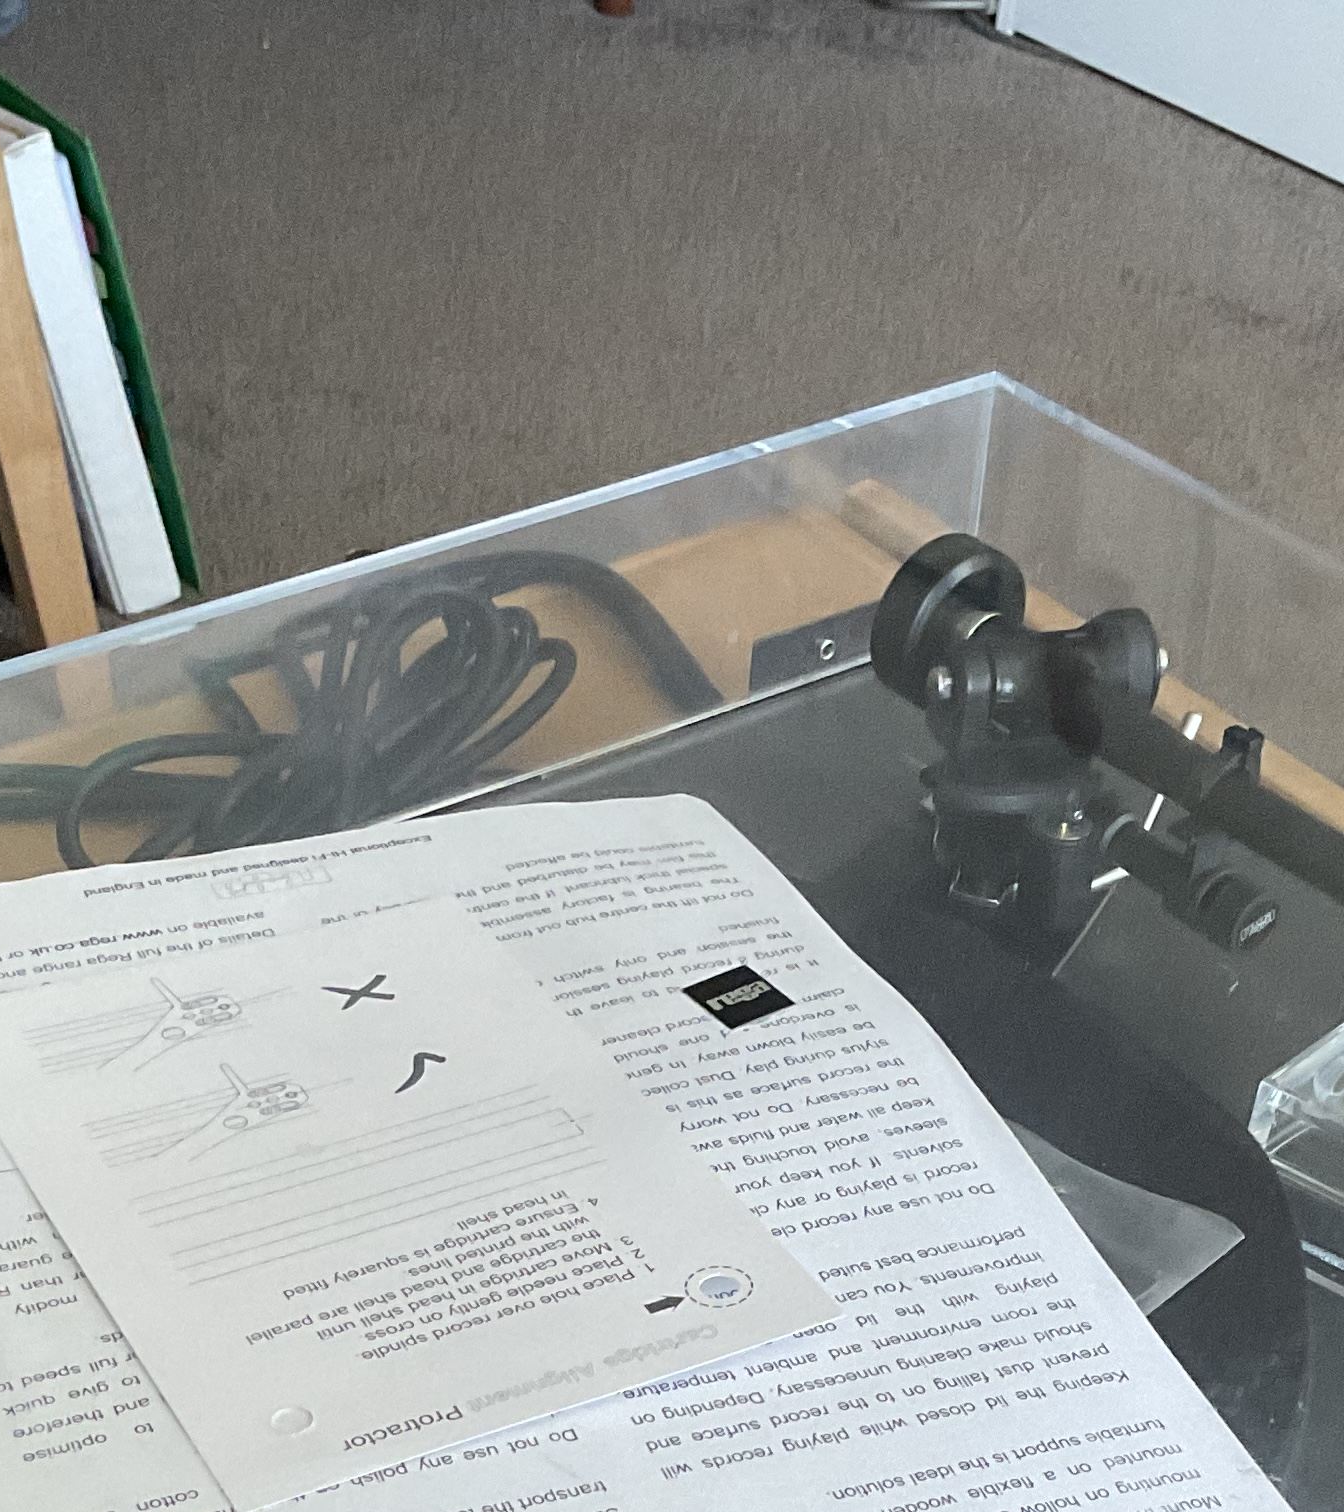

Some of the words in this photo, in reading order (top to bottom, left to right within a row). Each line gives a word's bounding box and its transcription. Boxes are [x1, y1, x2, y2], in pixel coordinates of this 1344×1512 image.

[164, 922, 189, 935] on
[190, 909, 265, 931] available
[5, 948, 25, 961] or
[559, 1240, 614, 1264] Move
[477, 1256, 559, 1289] cartridge
[569, 1253, 625, 1277] Place
[455, 1282, 479, 1296] in
[504, 1270, 569, 1298] needle
[580, 1266, 637, 1291] Place
[405, 1288, 458, 1315] head
[447, 1289, 504, 1317] gently
[537, 1284, 582, 1305] hole
[357, 1304, 405, 1329] shell
[416, 1310, 444, 1325] on
[495, 1298, 537, 1320] over
[314, 1319, 358, 1342] until
[429, 1311, 493, 1342] record
[1039, 1340, 1111, 1370] prevent
[930, 1369, 991, 1391] falling
[991, 1359, 1036, 1380] dust
[1050, 1368, 1131, 1393] Keeping
[873, 1389, 897, 1404] to
[899, 1382, 927, 1398] on
[982, 1392, 1011, 1411] lid
[1013, 1384, 1048, 1401] the
[835, 1395, 870, 1412] the
[913, 1400, 977, 1427] closed
[336, 1402, 466, 1454] Protractor
[767, 1403, 831, 1430] record
[856, 1415, 909, 1437] while
[689, 1418, 762, 1442] surface
[779, 1425, 851, 1453] playing
[1082, 1417, 1167, 1444] turntable
[643, 1434, 683, 1455] and
[1008, 1434, 1083, 1462] support
[699, 1444, 775, 1470] records
[956, 1454, 991, 1472] the
[990, 1449, 1012, 1465] is
[1100, 1442, 1184, 1472] mounted
[658, 1461, 694, 1481] will
[906, 1462, 957, 1487] ideal
[1040, 1468, 1058, 1482] a
[1064, 1461, 1093, 1477] on
[1112, 1466, 1203, 1495] mounting
[965, 1474, 1035, 1501] flexible
[1082, 1486, 1111, 1502] on
